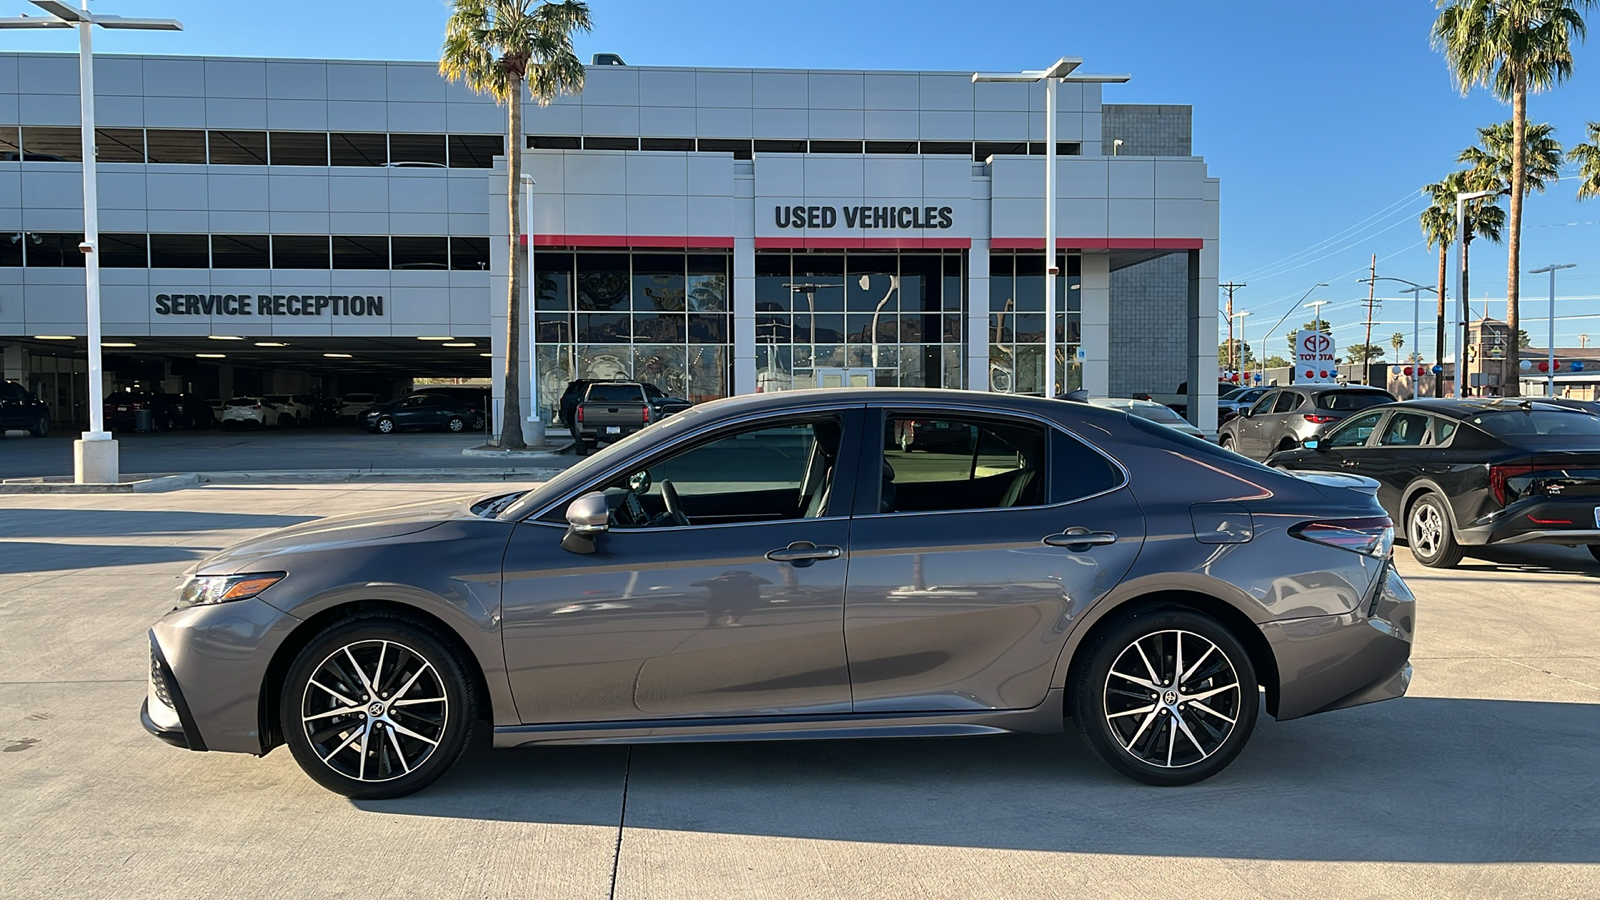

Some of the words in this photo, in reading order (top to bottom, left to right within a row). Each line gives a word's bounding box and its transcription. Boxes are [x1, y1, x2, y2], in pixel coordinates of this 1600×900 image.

[775, 206, 837, 228] USED
[843, 206, 953, 229] VEHICLES
[155, 294, 252, 315] SERVICE
[257, 295, 384, 316] RECEPTION
